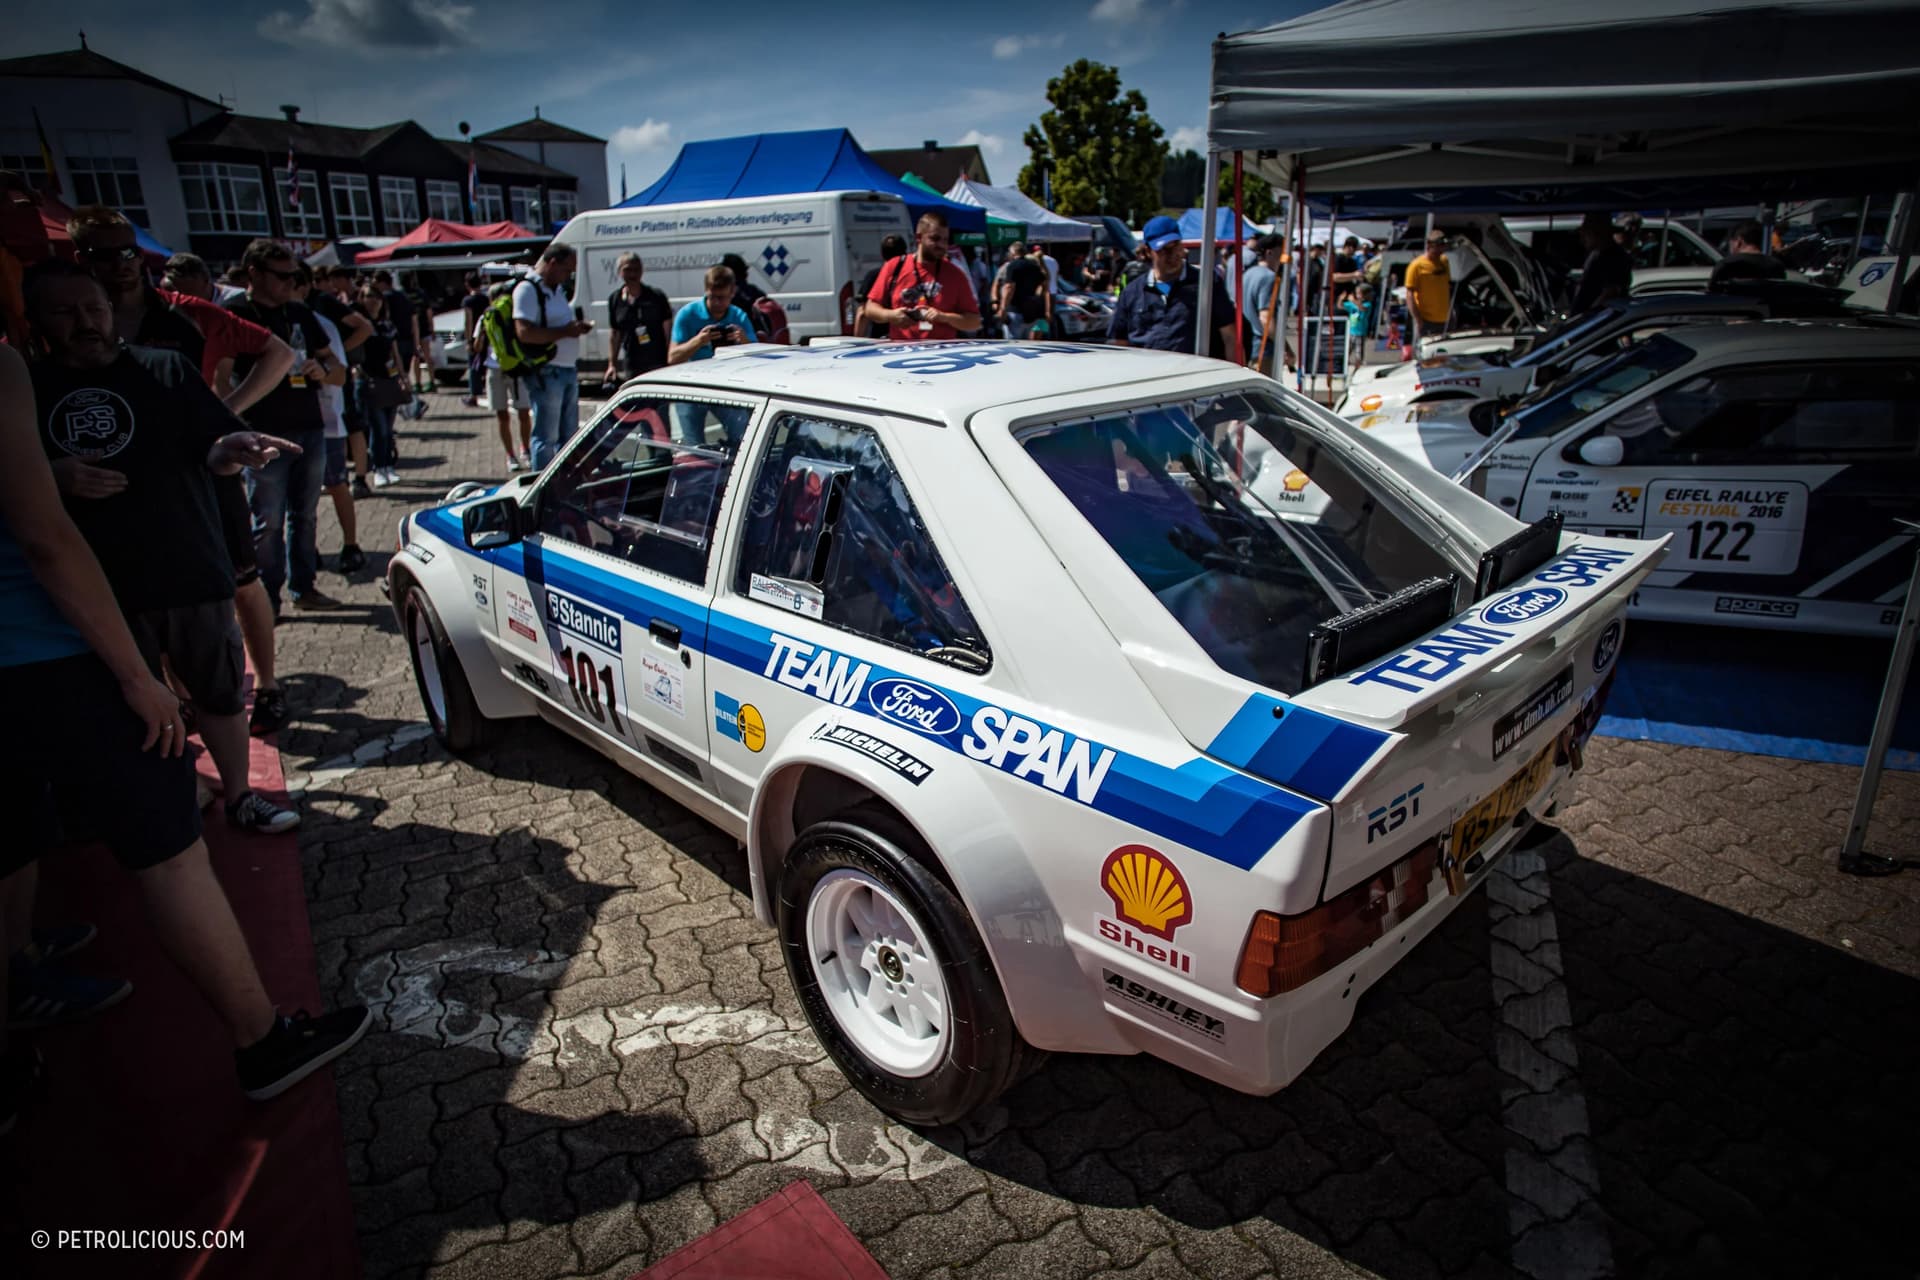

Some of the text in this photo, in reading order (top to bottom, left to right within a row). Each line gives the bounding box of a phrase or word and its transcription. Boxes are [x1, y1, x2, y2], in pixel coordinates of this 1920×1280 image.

[595, 223, 632, 236] Fliesen
[640, 220, 678, 233] Platten
[1279, 492, 1305, 503] Shell
[1659, 503, 1784, 518] FESTIVAL 2016
[1665, 488, 1790, 504] EIFEL RALLYE
[1687, 521, 1755, 561] 122
[560, 598, 618, 648] Stannic
[1348, 546, 1635, 694] TEAM Ford SPAN
[1717, 597, 1797, 614] sparco
[560, 645, 626, 737] 101
[764, 632, 1117, 805] TEAM Ford SPAN
[832, 728, 931, 780] MICHELIN
[1367, 781, 1425, 845] RST
[1099, 919, 1190, 974] Shell
[1105, 972, 1225, 1030] ASHLEY
